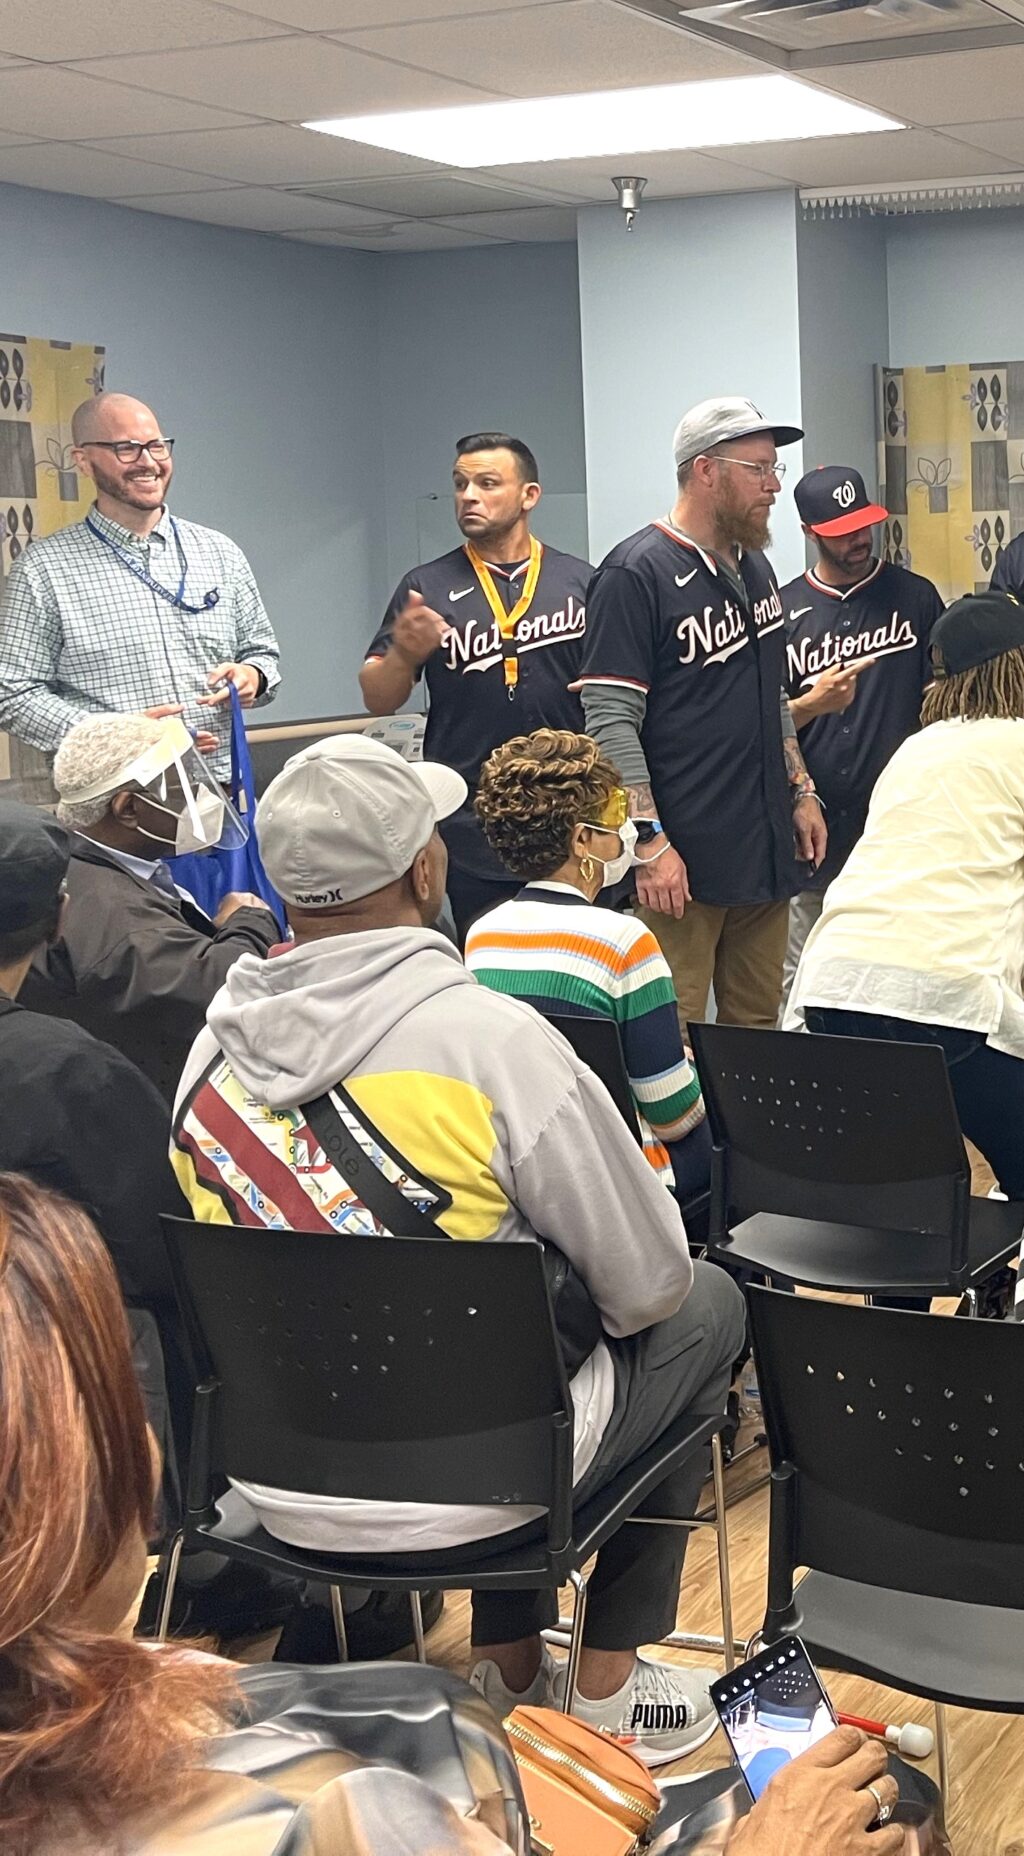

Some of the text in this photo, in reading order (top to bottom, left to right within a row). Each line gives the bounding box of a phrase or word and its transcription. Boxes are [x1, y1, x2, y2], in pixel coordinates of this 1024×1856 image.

[832, 480, 857, 509] W
[786, 611, 918, 683] Nationals
[630, 1703, 688, 1729] PUMA
